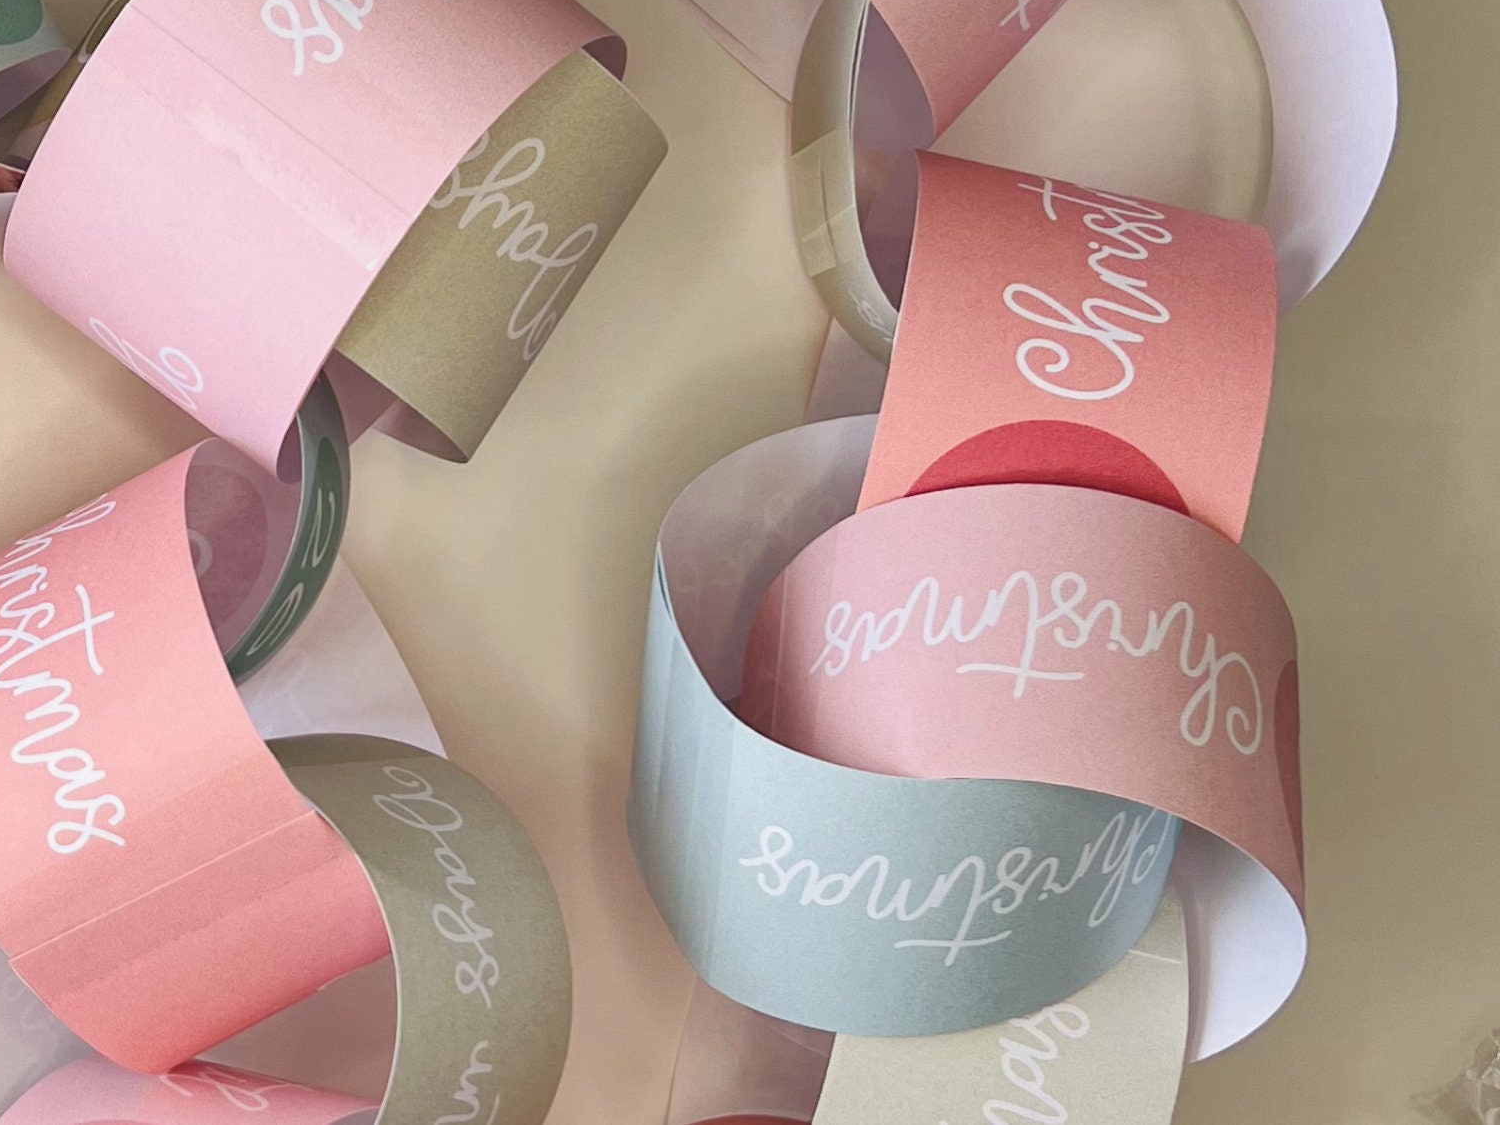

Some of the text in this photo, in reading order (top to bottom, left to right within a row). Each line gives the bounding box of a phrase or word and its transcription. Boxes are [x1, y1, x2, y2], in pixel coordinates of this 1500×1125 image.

[1003, 177, 1172, 401] Christ
[810, 571, 1262, 753] Christmas
[372, 765, 499, 1008] Days
